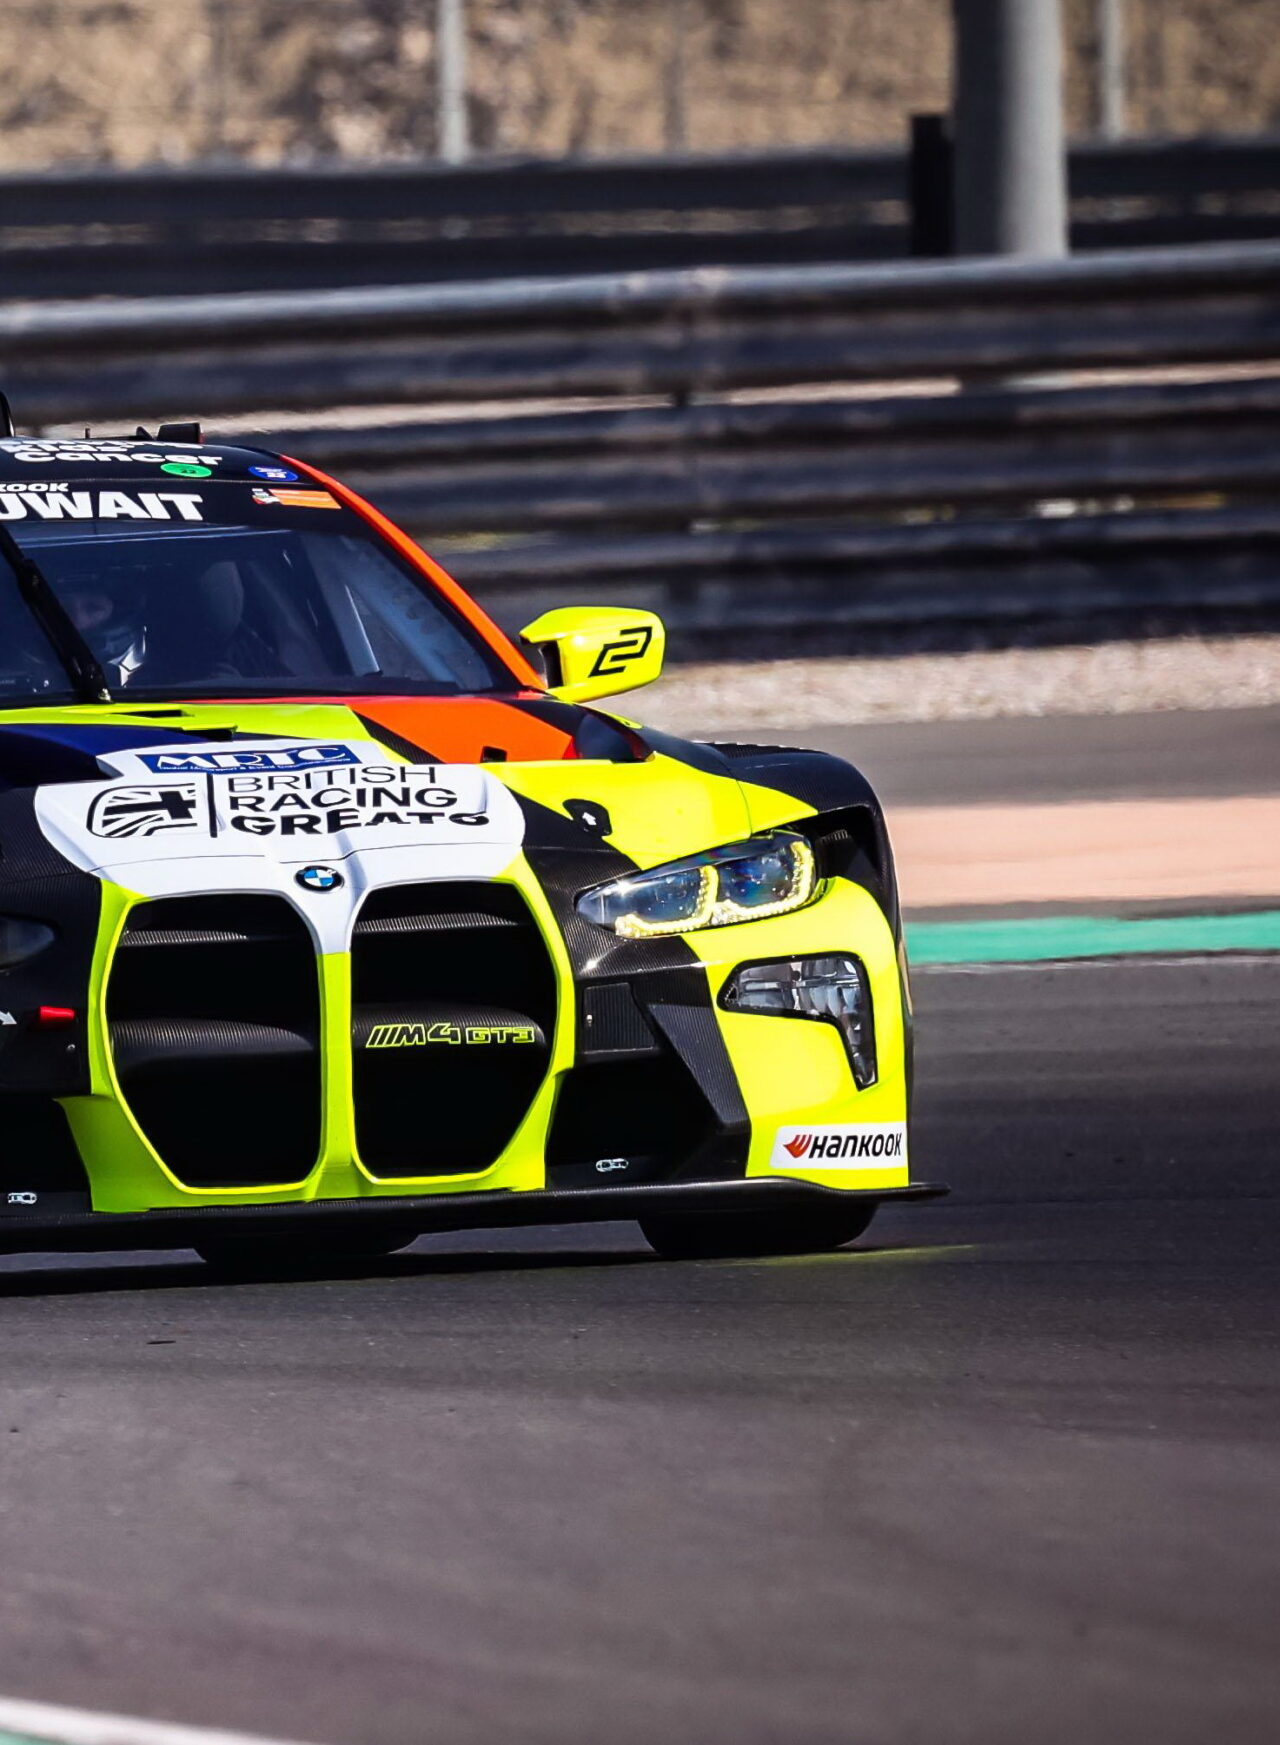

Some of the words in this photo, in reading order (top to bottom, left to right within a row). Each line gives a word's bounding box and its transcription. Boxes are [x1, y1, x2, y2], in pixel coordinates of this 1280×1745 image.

[14, 452, 223, 466] Cancer
[227, 766, 437, 794] BRITISH
[228, 787, 458, 813] RACING
[230, 808, 491, 836] GREATS
[465, 1026, 535, 1045] GT3
